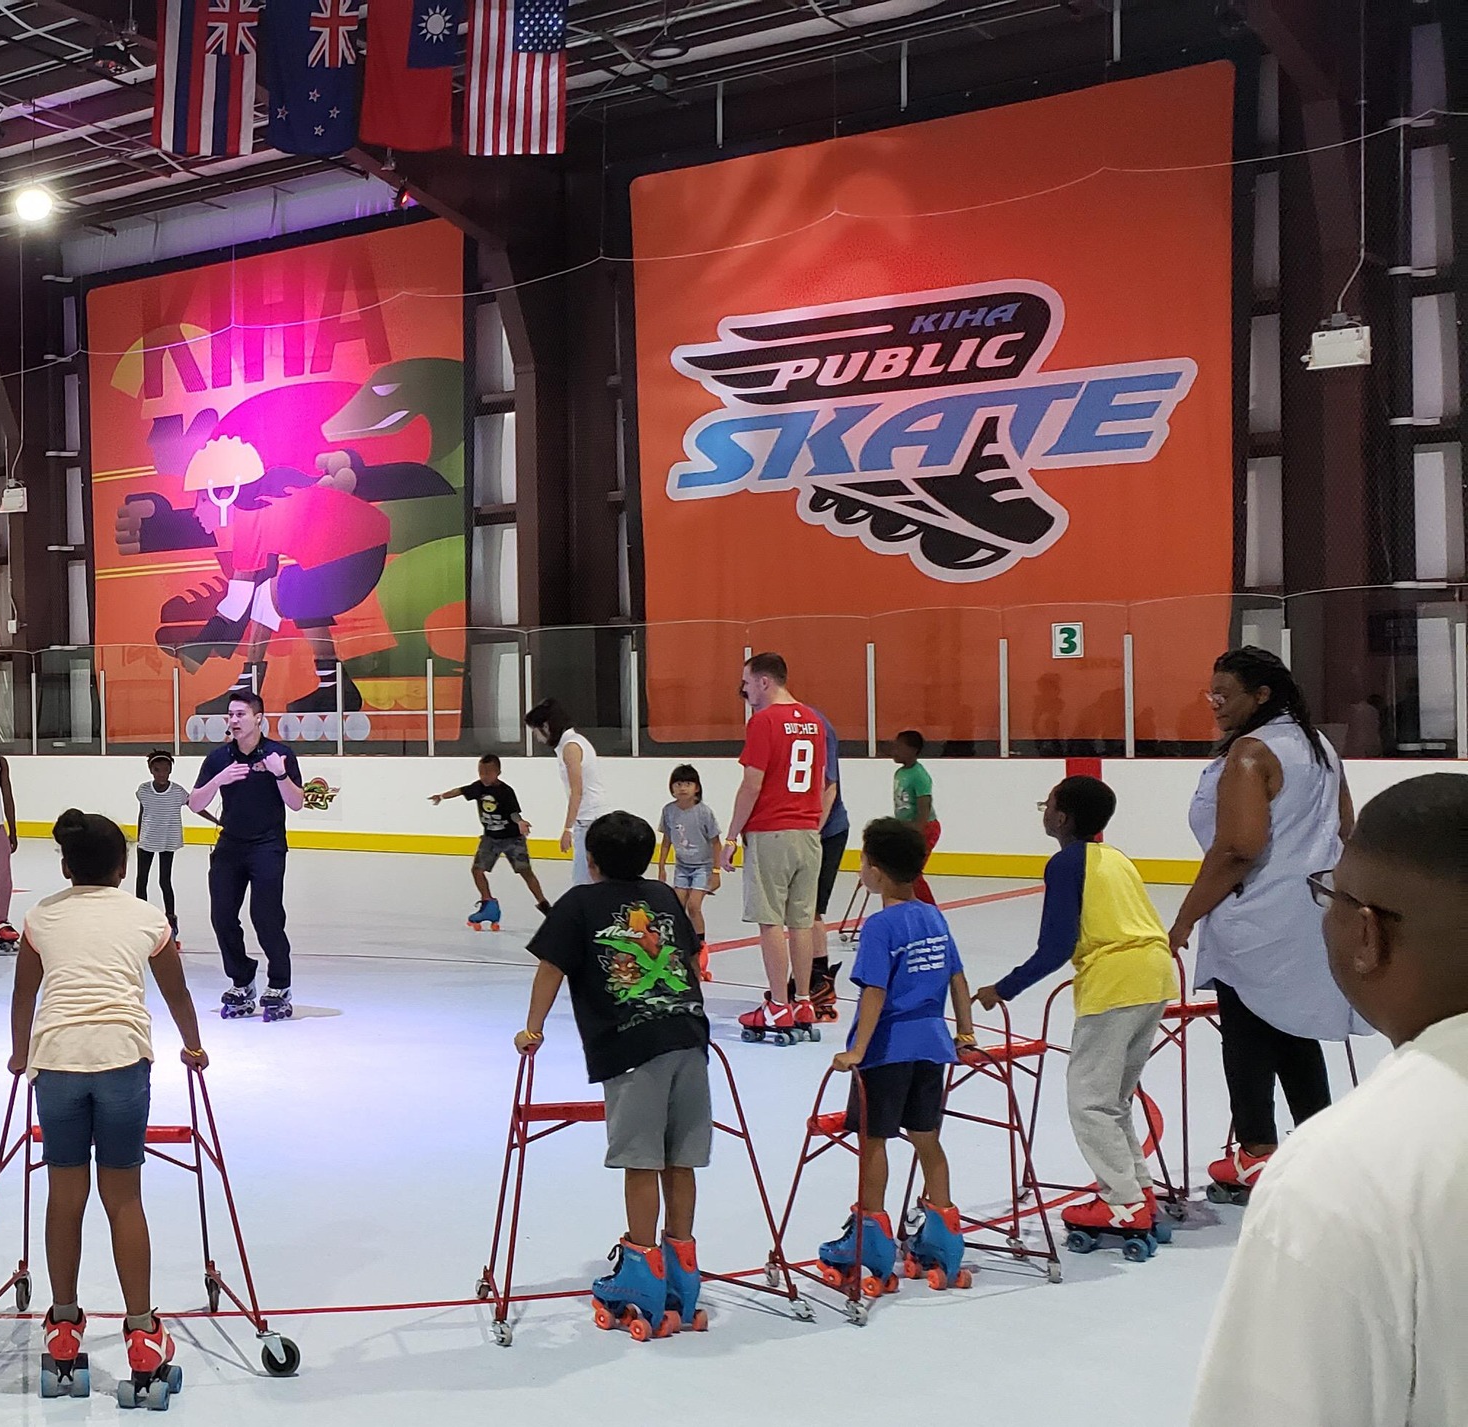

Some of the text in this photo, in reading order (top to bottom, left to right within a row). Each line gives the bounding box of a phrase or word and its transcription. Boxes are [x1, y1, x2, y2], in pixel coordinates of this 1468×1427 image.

[142, 248, 392, 400] KIHA
[908, 302, 1023, 335] KIHA
[773, 331, 1026, 391] PUBLIC
[677, 371, 1182, 489] SKATE
[1059, 627, 1077, 654] 3
[787, 740, 814, 793] 8
[594, 925, 644, 939] Aloha
